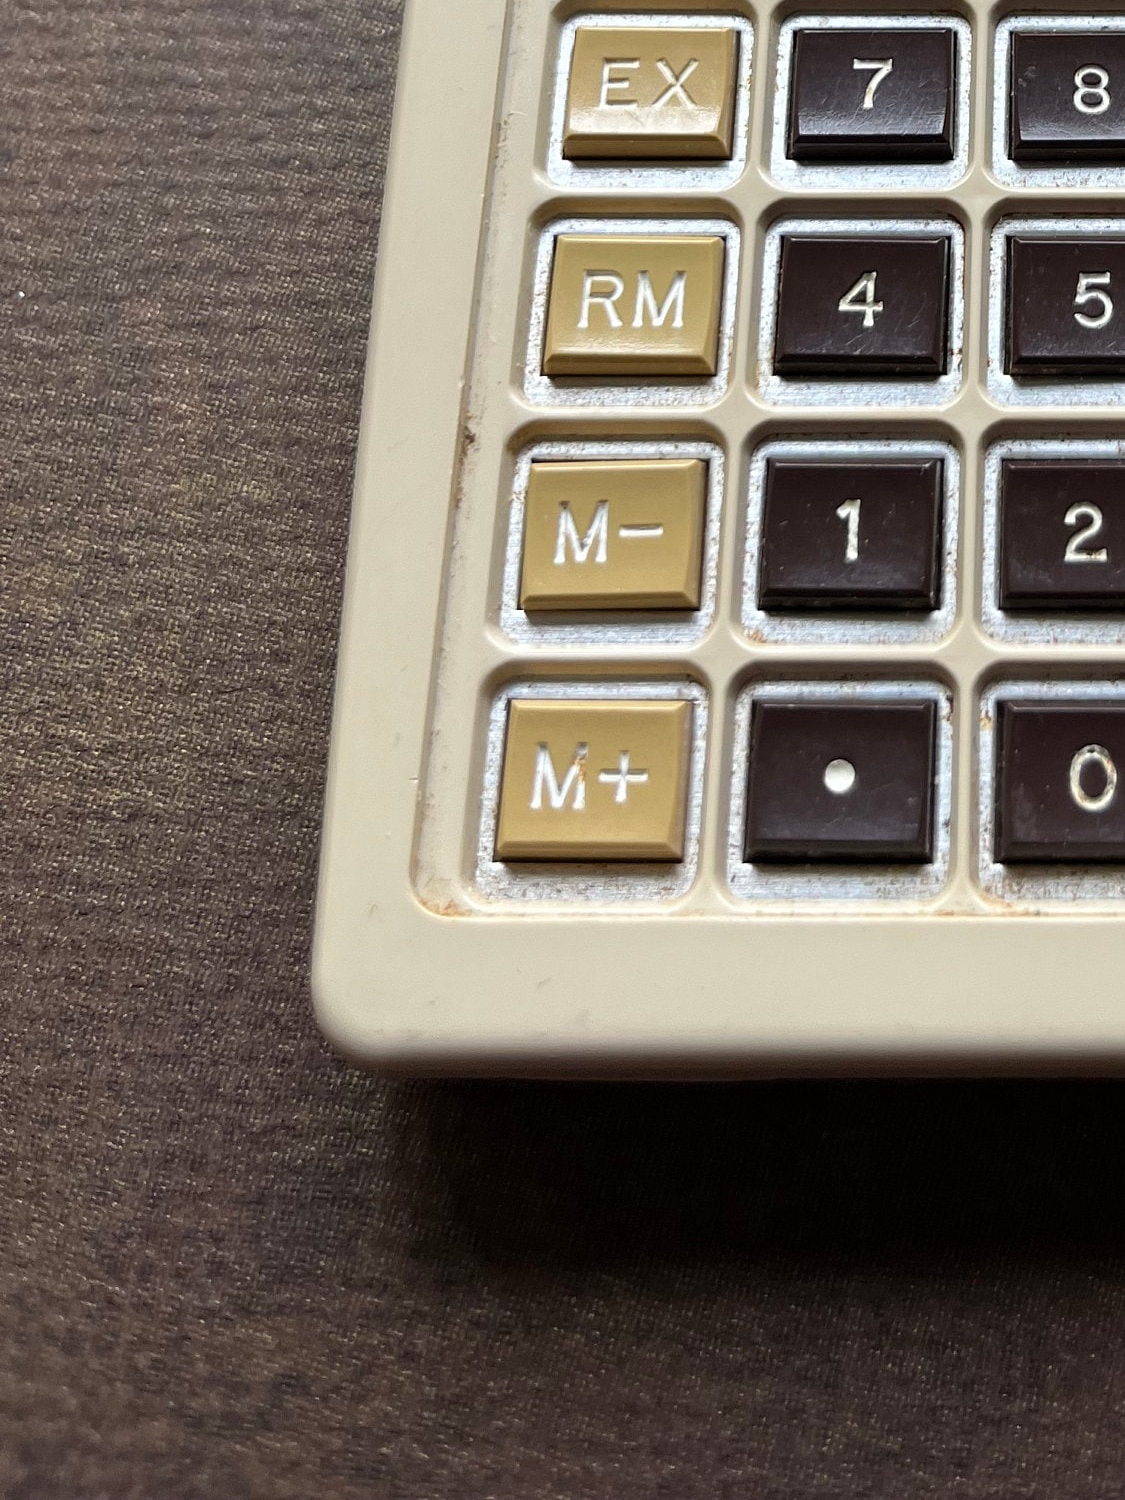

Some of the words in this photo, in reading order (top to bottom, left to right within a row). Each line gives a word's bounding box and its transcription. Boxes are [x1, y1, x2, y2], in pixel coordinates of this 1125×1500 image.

[597, 57, 701, 108] EX
[852, 57, 894, 110] 7
[1071, 65, 1110, 115] 8
[577, 272, 686, 328] RM
[837, 271, 884, 327] 4
[1072, 271, 1115, 330] 5
[835, 498, 862, 562] 1
[1063, 502, 1109, 564] 2
[528, 742, 650, 810] M+
[1067, 745, 1117, 811] 0
